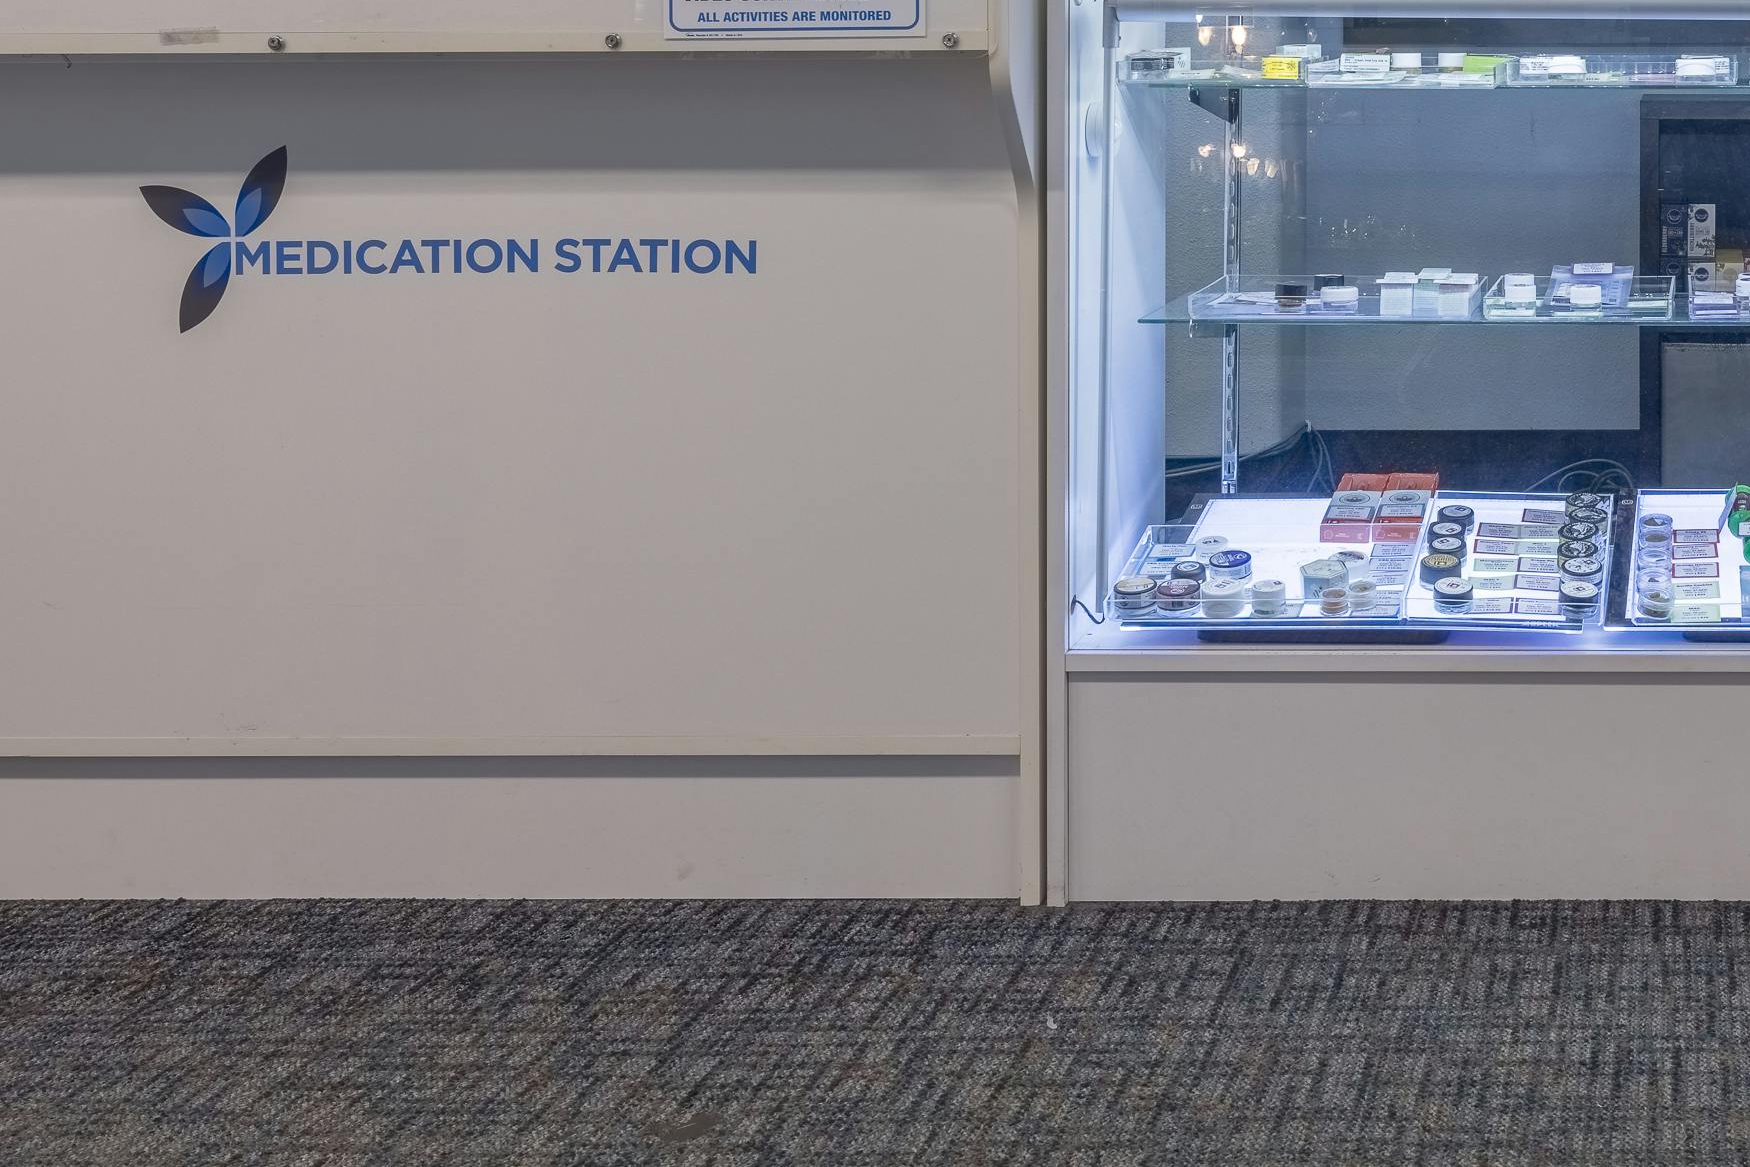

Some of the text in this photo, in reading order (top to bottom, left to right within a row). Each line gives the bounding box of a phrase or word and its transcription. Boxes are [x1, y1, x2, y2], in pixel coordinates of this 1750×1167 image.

[697, 9, 891, 23] ALL ACTIVITIES ARE MONITORED
[234, 237, 757, 276] MEDICATION STATION
